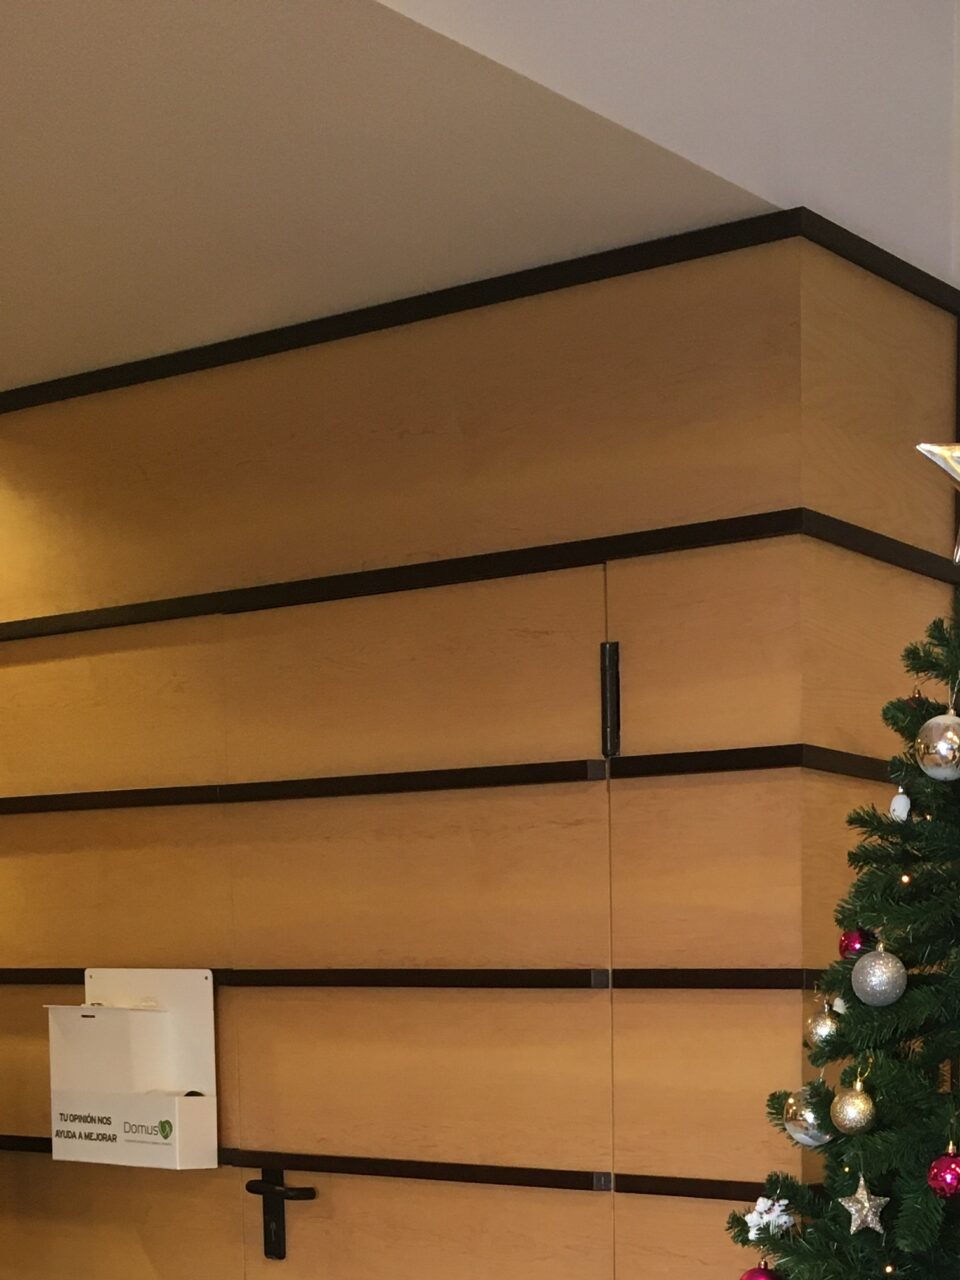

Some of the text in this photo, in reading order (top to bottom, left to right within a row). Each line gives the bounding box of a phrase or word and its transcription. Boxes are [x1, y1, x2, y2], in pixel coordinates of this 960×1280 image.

[59, 1113, 112, 1126] TU OPINIÓN NOS
[55, 1129, 76, 1139] AYUDA
[78, 1132, 83, 1140] A
[84, 1132, 117, 1143] MEJORAR
